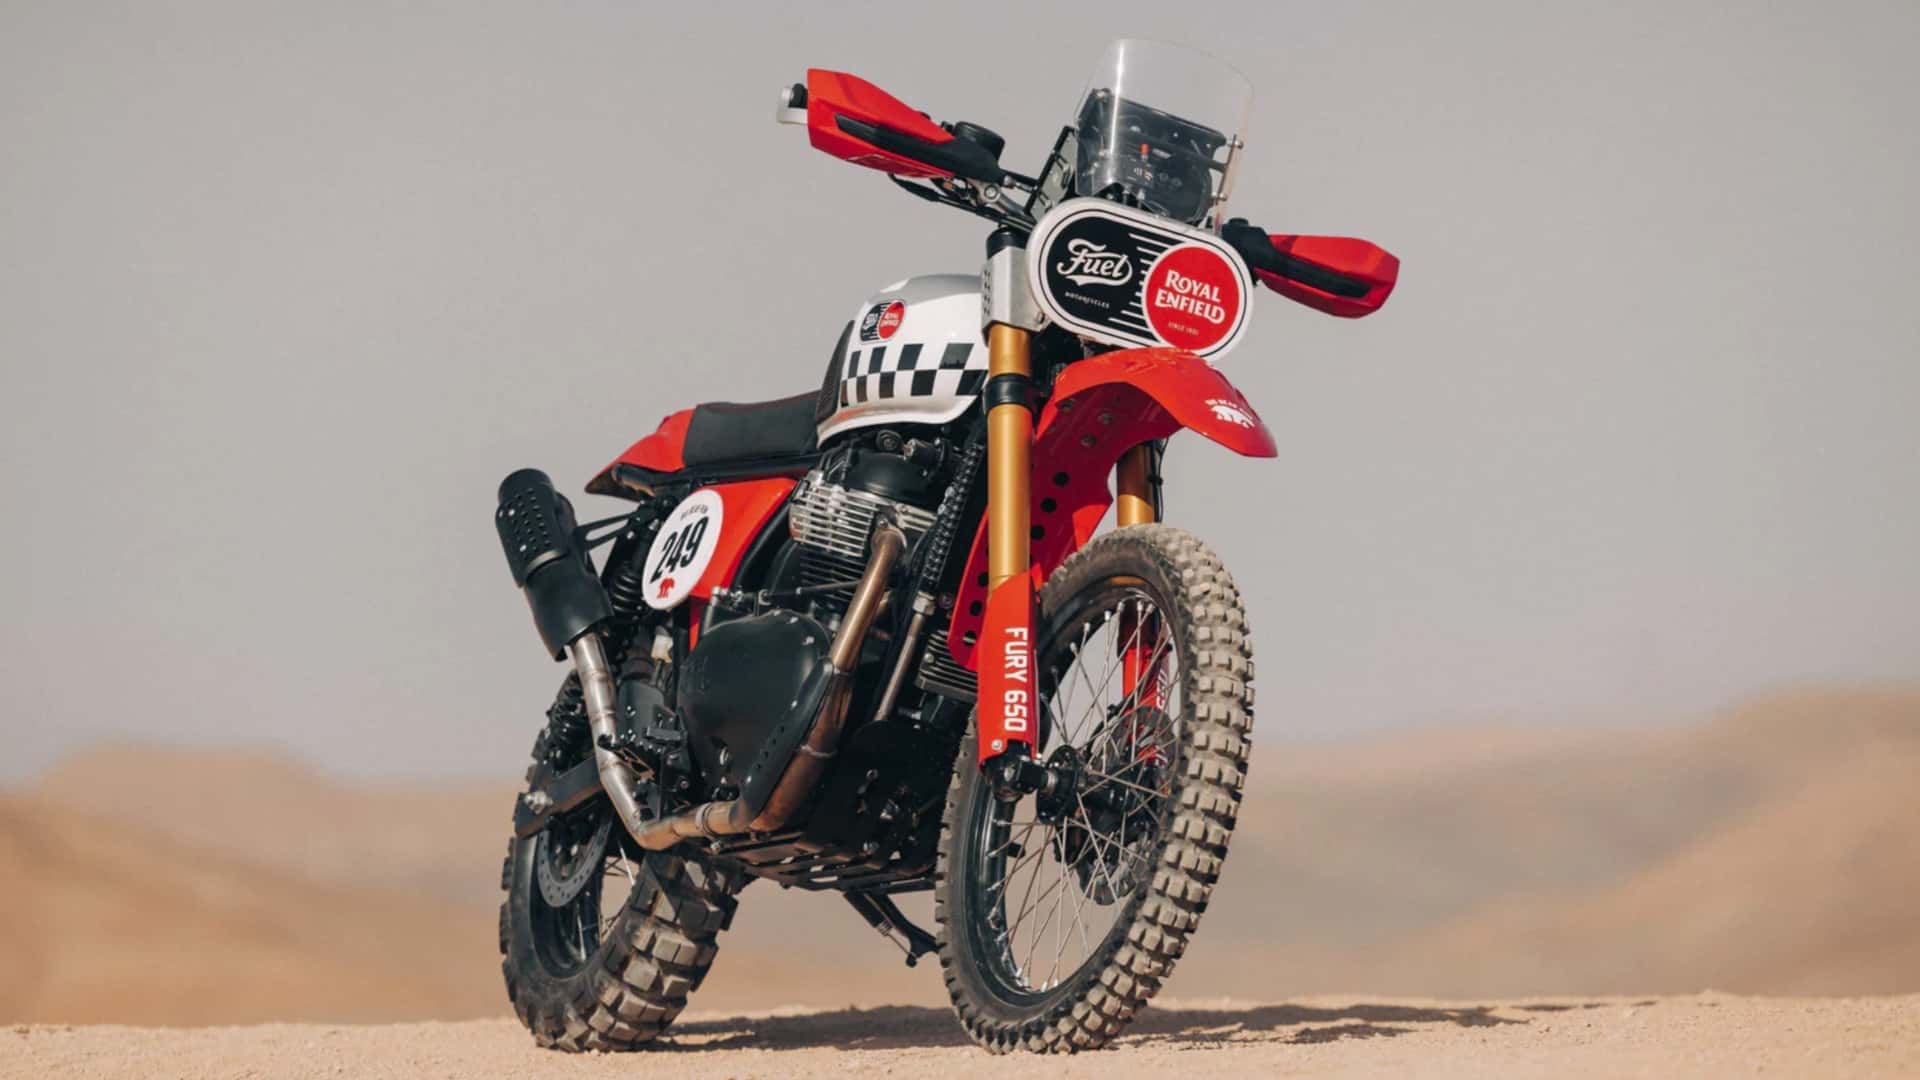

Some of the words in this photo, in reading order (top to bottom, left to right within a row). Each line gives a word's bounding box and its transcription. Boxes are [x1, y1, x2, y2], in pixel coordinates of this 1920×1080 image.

[1056, 238, 1133, 286] Fuel
[1154, 287, 1226, 325] ENFIELD
[1164, 269, 1222, 303] ROYAL
[650, 516, 709, 584] 249
[1004, 627, 1029, 683] FURY
[1004, 690, 1028, 732] 650
